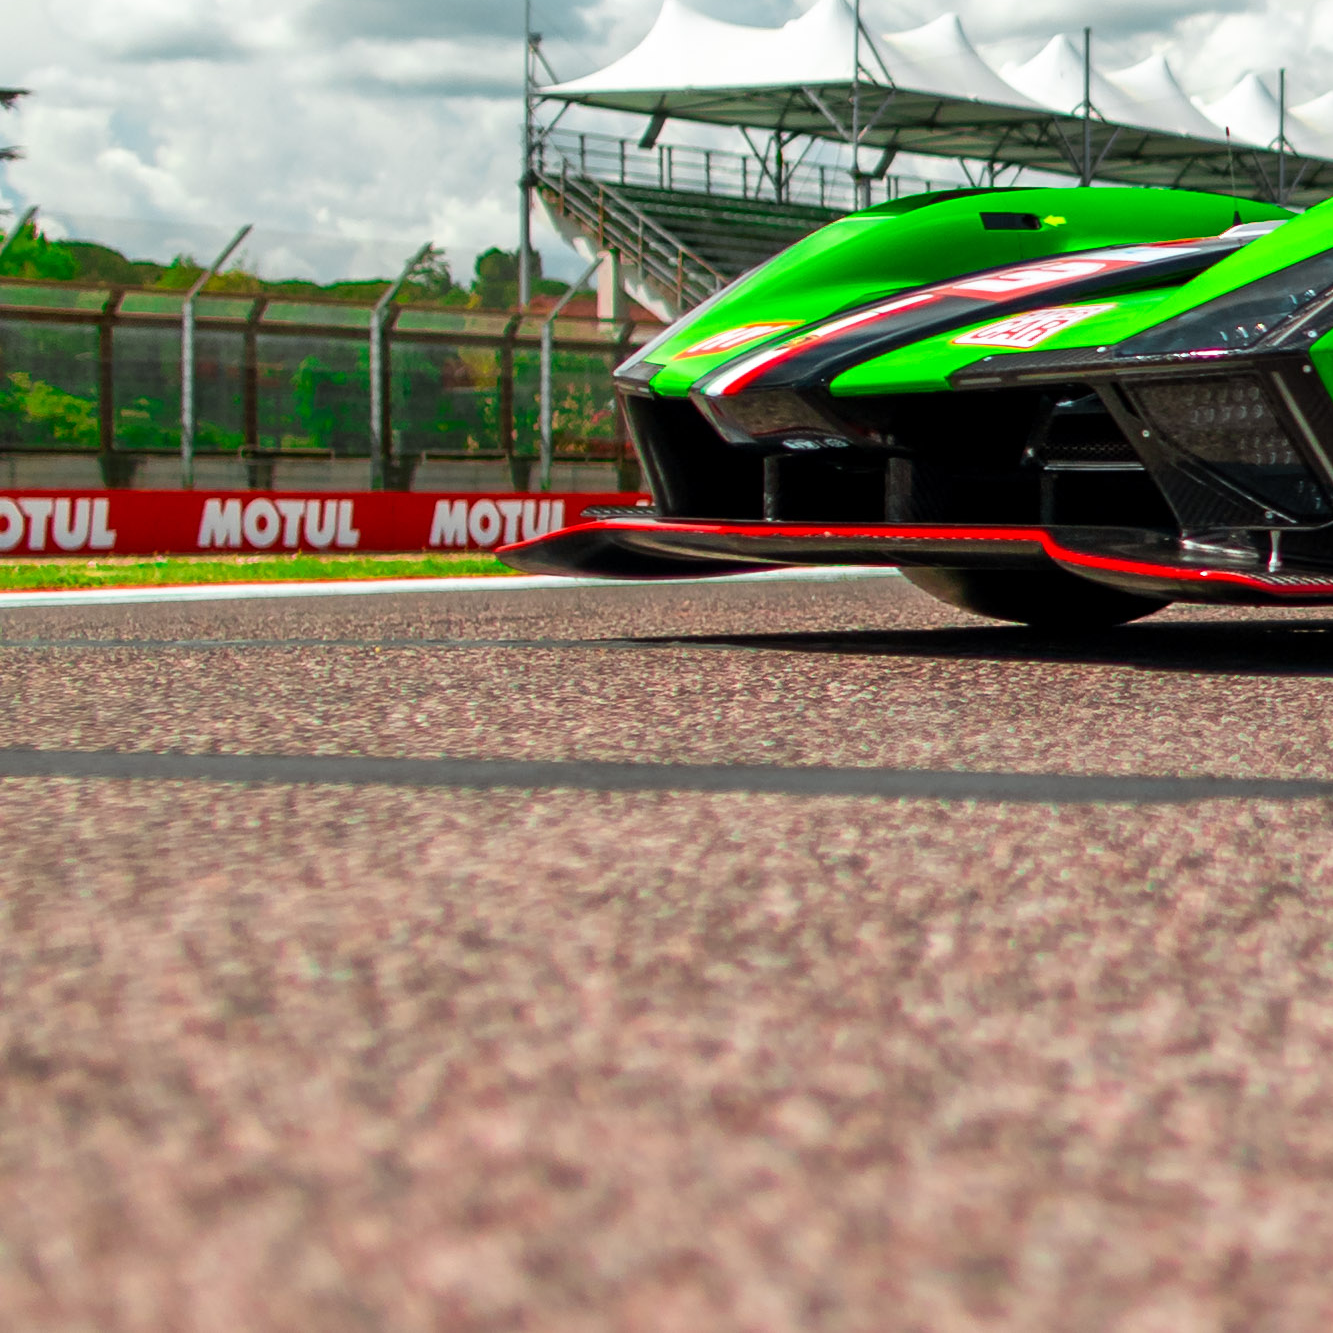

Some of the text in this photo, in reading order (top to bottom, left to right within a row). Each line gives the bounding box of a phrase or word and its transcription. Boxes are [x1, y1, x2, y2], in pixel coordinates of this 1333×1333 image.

[0, 497, 117, 553] OTUL
[197, 497, 360, 549] MOTUL
[429, 499, 566, 547] MOTUL
